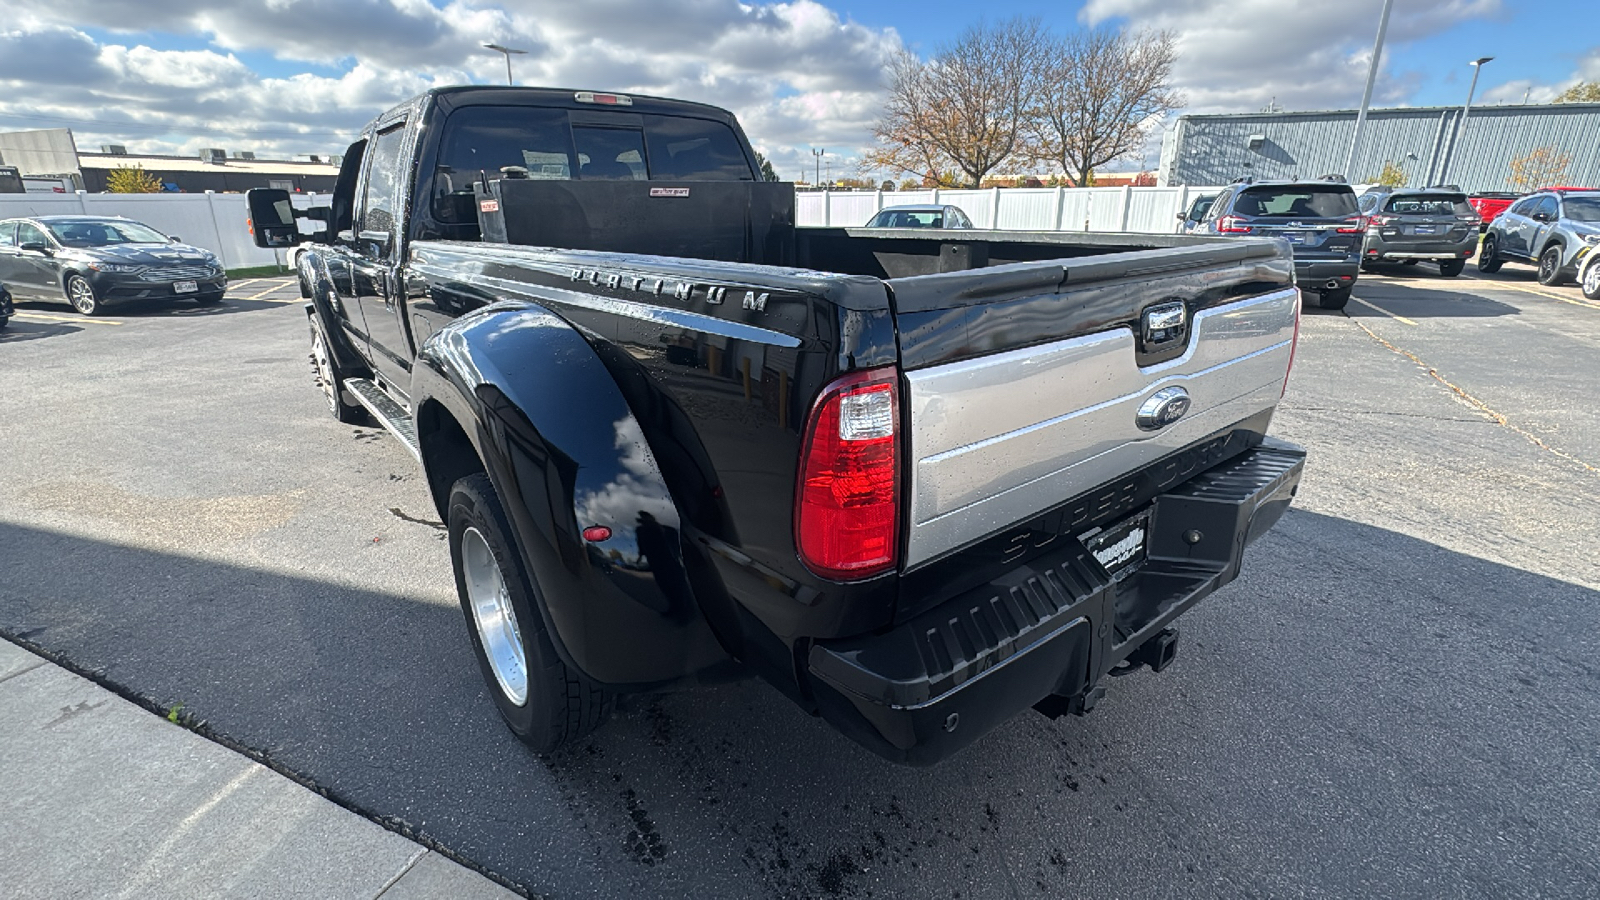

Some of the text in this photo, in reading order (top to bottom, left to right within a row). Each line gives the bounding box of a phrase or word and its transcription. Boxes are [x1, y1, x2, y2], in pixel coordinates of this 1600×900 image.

[571, 269, 770, 312] PLATINUM
[1165, 401, 1186, 421] Ford
[1002, 483, 1136, 565] SUPER
